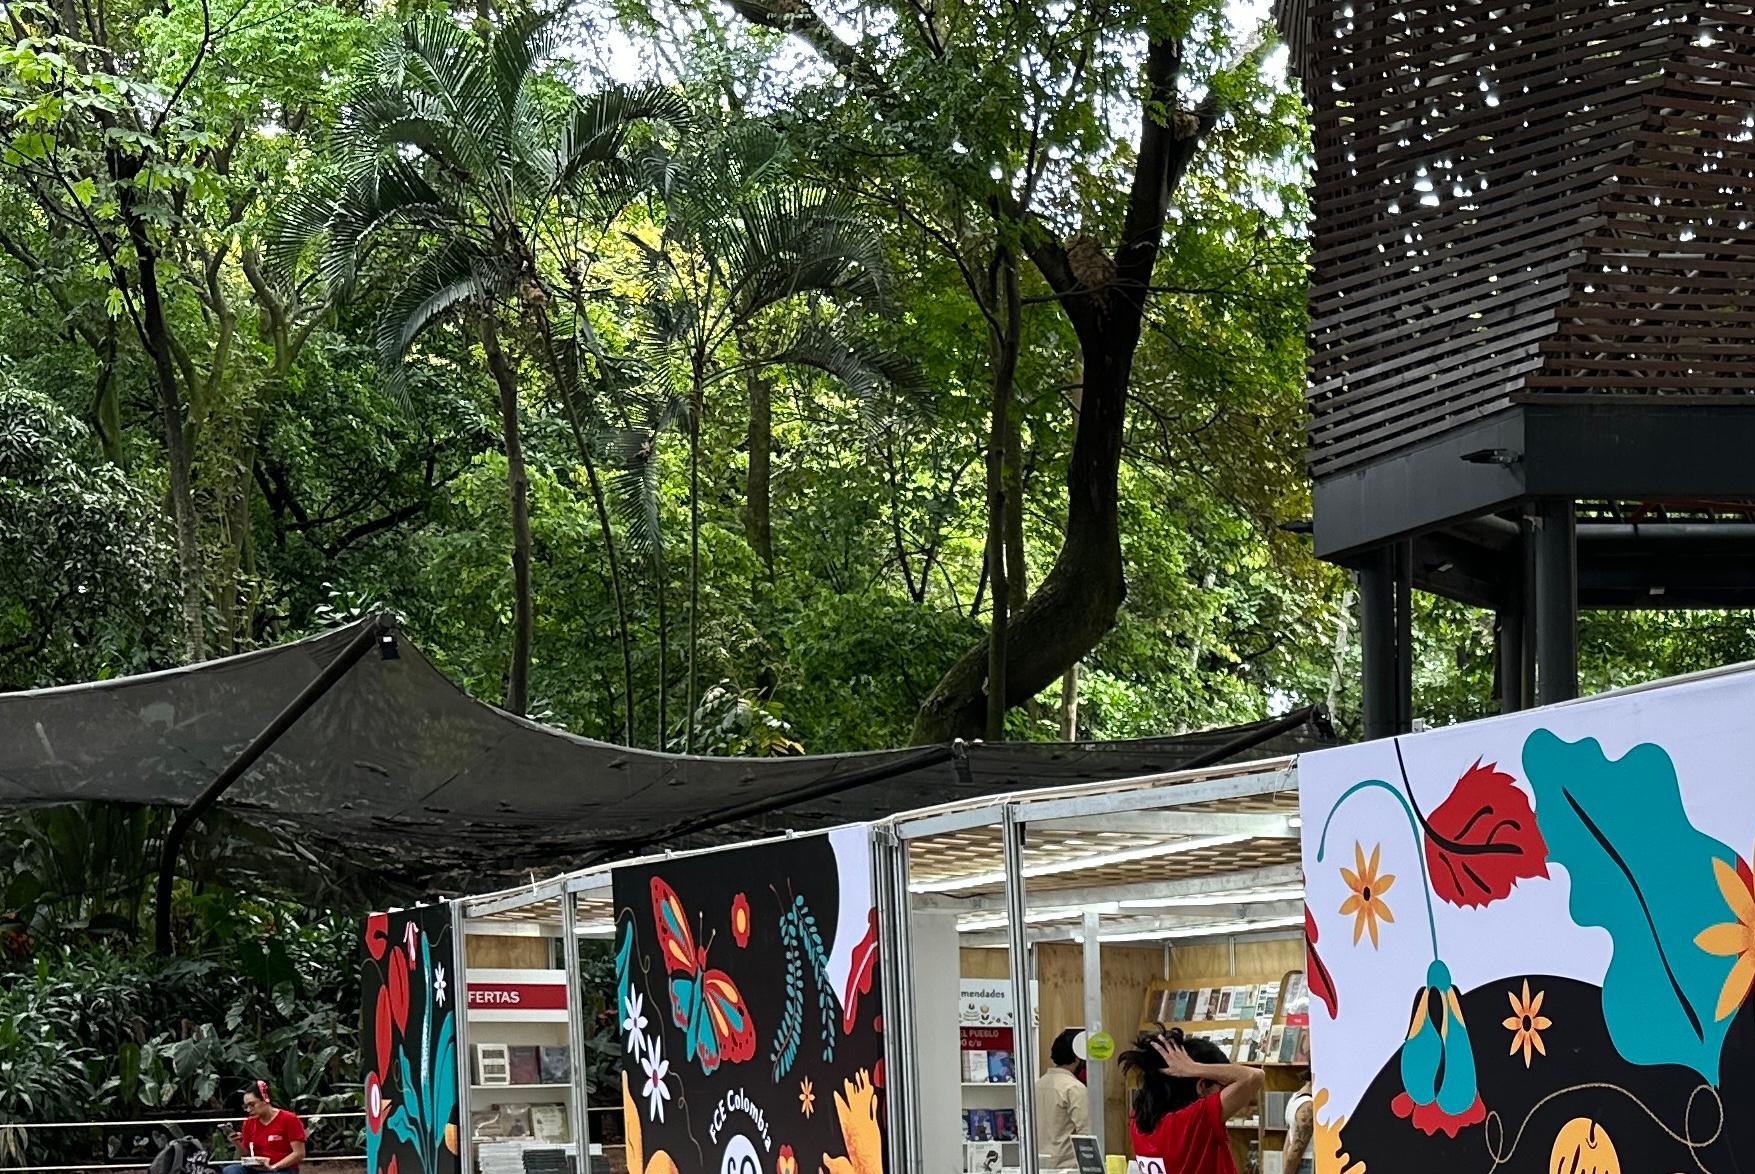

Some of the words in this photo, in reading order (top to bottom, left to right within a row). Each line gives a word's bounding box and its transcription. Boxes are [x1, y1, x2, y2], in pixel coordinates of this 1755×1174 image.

[467, 991, 520, 1004] FERTAS
[960, 989, 1005, 999] mendados
[969, 1029, 999, 1038] PUEBLO
[709, 1099, 727, 1144] FCE
[726, 1087, 772, 1153] Colombia
